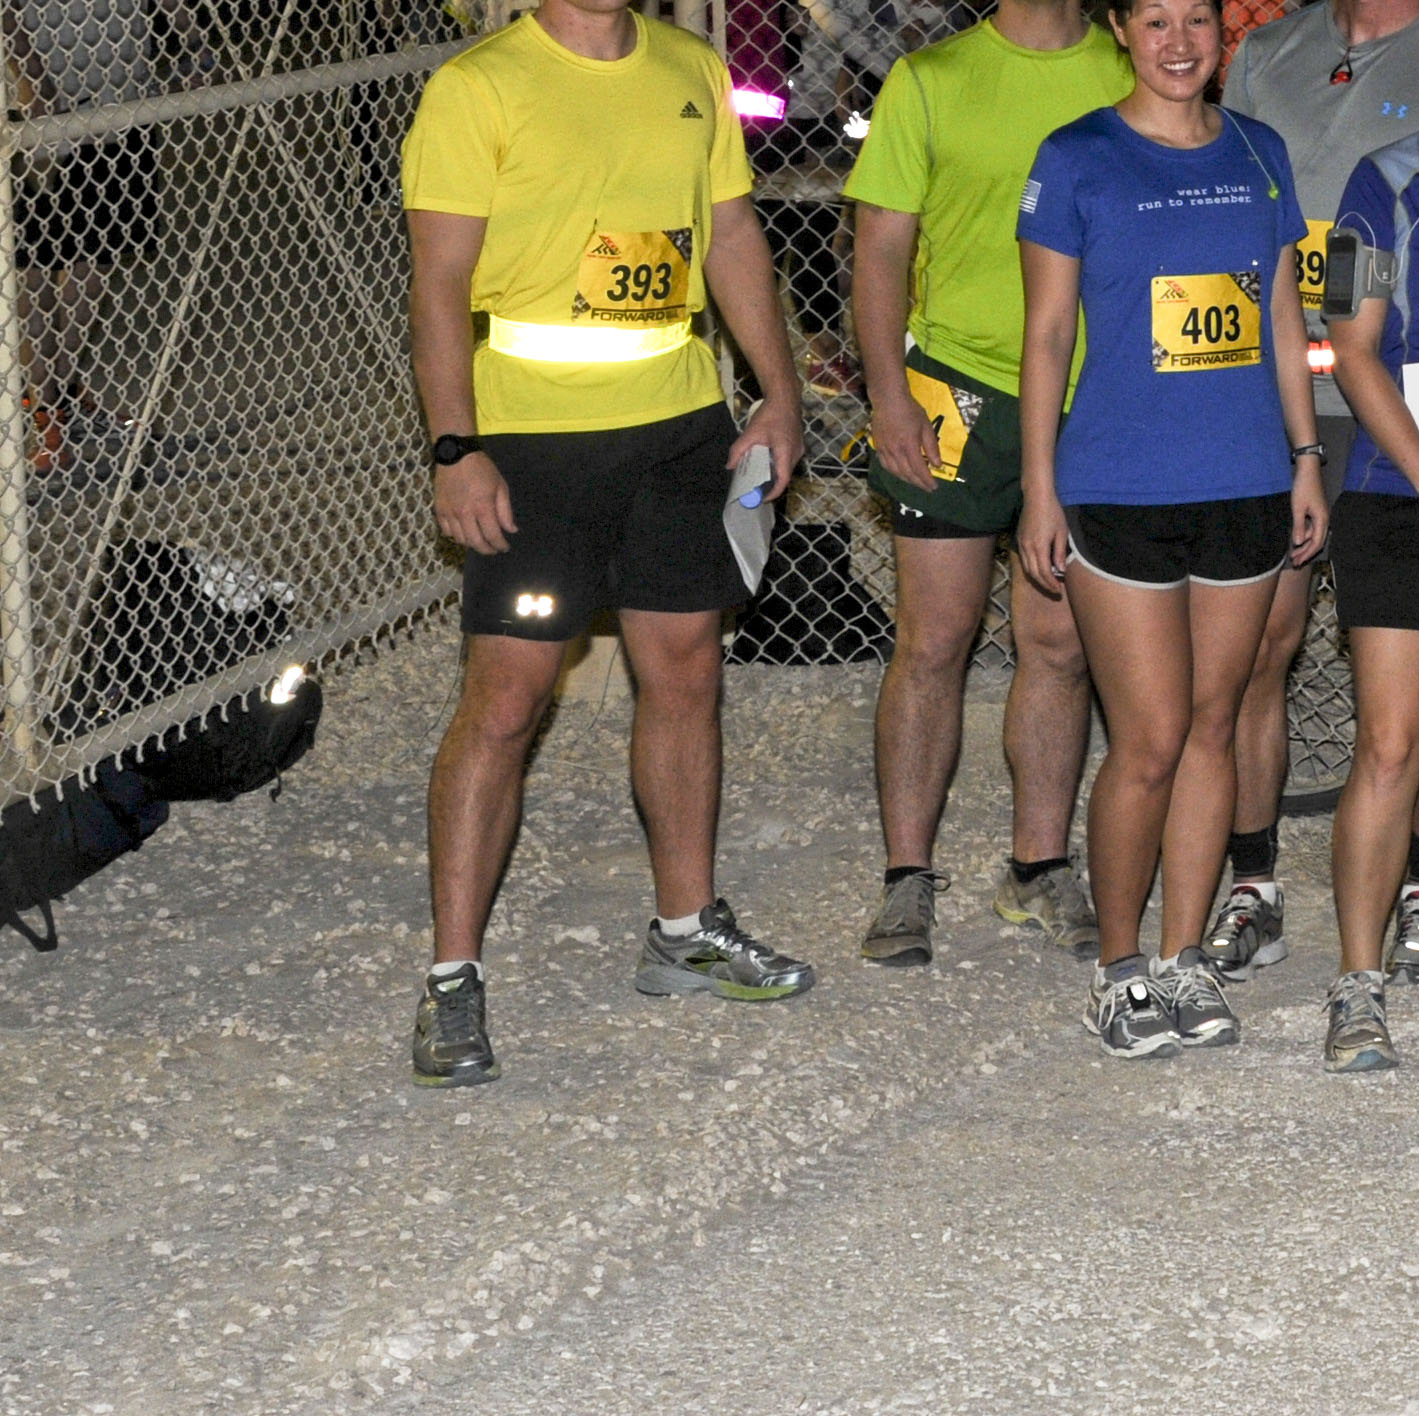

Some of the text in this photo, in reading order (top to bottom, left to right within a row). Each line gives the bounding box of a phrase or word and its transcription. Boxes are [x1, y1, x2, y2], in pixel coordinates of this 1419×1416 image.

[1177, 187, 1208, 197] wear
[1137, 194, 1252, 212] run to remember
[606, 262, 672, 302] 393
[591, 307, 666, 322] FORWARD
[1181, 304, 1241, 345] 403
[1170, 352, 1239, 367] FORWARD
